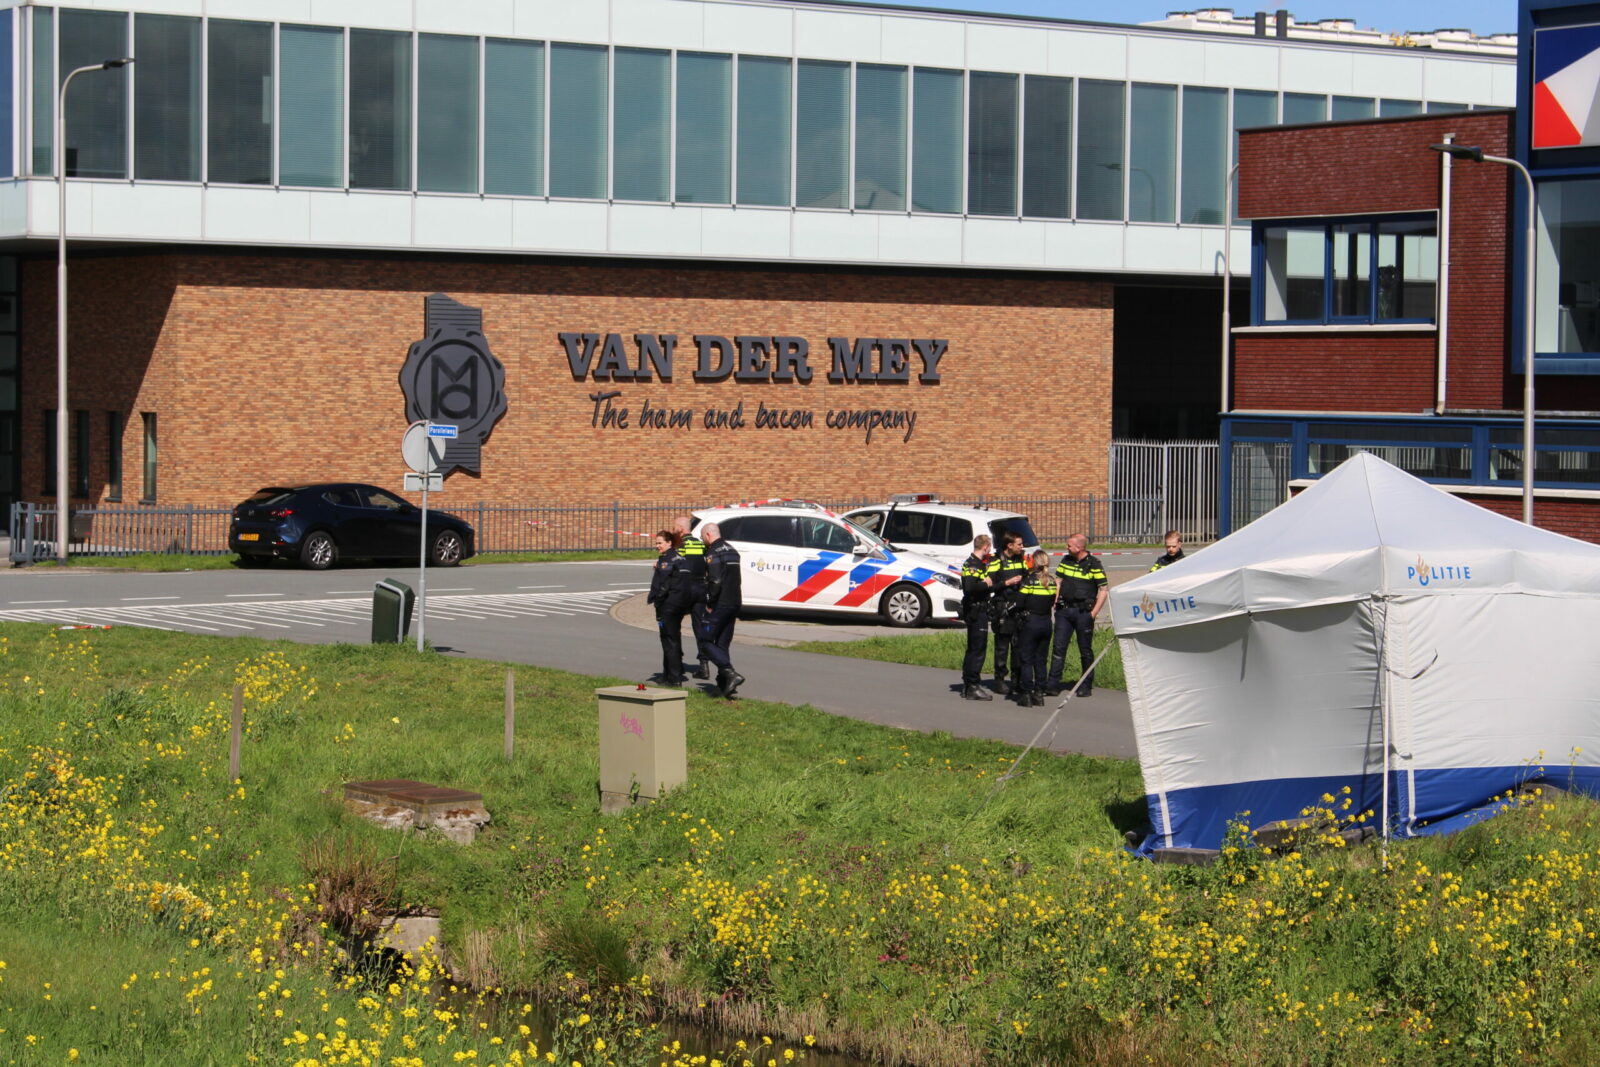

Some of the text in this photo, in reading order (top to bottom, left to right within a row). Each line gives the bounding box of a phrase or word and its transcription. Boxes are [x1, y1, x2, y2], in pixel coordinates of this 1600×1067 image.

[558, 332, 949, 386] VAN DER MEY
[589, 391, 918, 445] The ham and bacon company
[751, 560, 793, 572] POLITIE
[1408, 561, 1472, 586] POLITIE
[1132, 594, 1197, 622] POLITIE
